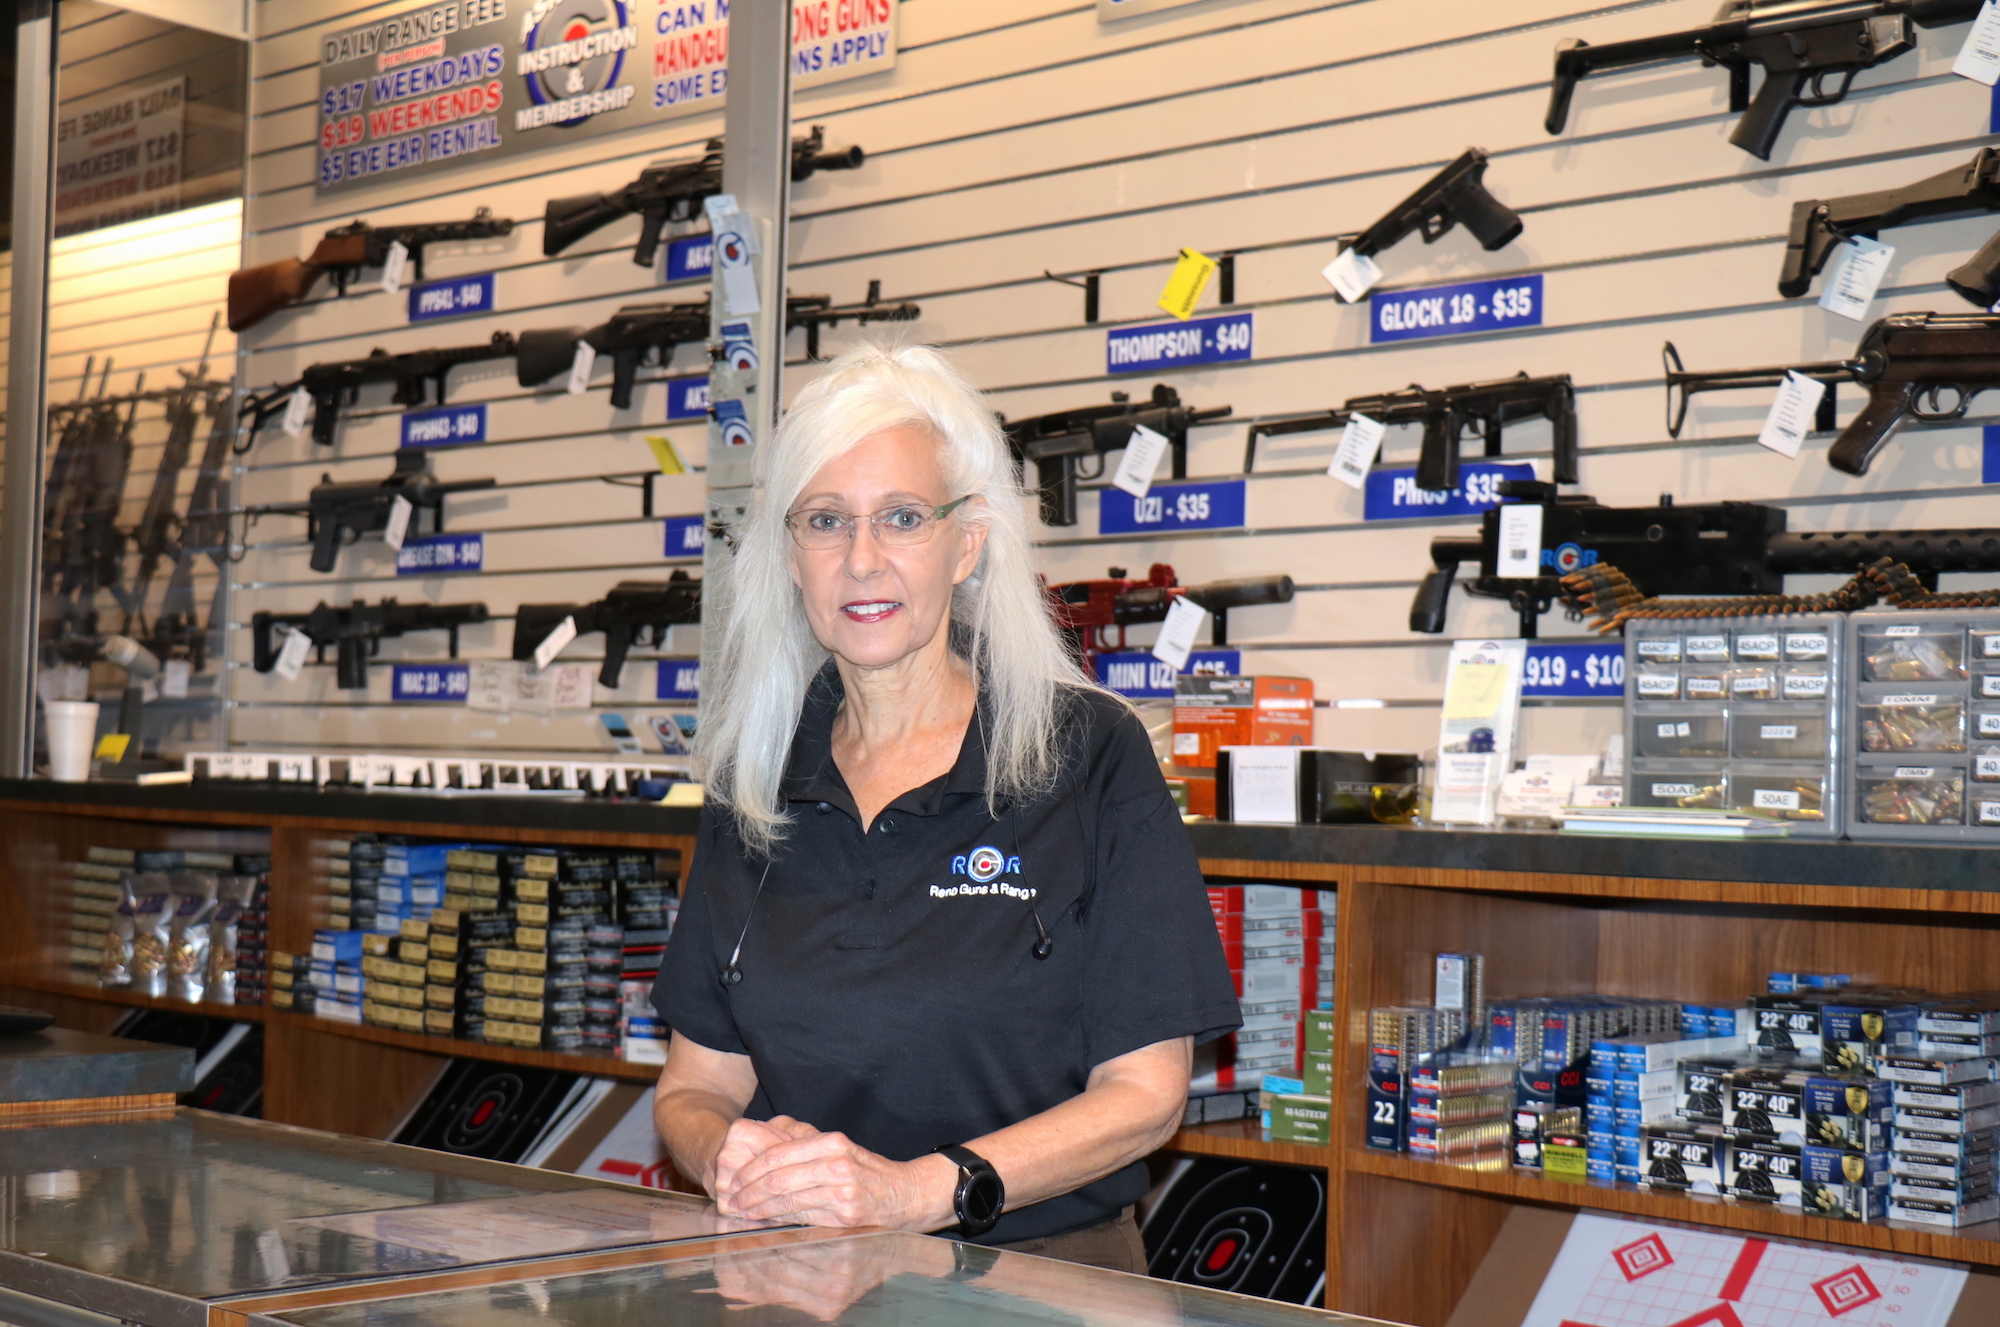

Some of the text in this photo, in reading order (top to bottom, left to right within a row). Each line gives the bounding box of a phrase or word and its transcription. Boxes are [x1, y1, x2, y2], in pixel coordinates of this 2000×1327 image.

[656, 4, 705, 35] CAN
[836, 0, 891, 33] GUNS
[325, 0, 506, 66] DAILY RANGE FEE
[517, 25, 638, 76] INSTRUCTION
[829, 29, 890, 68] APPLY
[324, 44, 504, 117] $17 WEEKDAYS
[566, 67, 585, 94] &
[653, 74, 705, 110] SOME
[322, 81, 503, 151] $19 WEEKENDS
[515, 84, 636, 132] MEMBERSHIP
[320, 152, 345, 186] $5
[428, 117, 502, 162] RENTAL
[1380, 297, 1445, 331] GLOCK
[1449, 294, 1475, 323] 18
[1492, 287, 1532, 321] $35
[1109, 328, 1202, 365] THOMPSON
[1216, 322, 1250, 354] $40
[1465, 472, 1504, 505] $35
[1134, 496, 1163, 523] UZI
[1176, 492, 1210, 523] $35
[1688, 638, 1722, 650] 45ACP
[1738, 640, 1775, 652] 45ACP
[1788, 639, 1825, 650] 45ACP
[1107, 662, 1146, 689] MINI
[1521, 655, 1566, 687] 919
[1584, 653, 1625, 688] $10
[401, 671, 424, 694] MAC
[425, 671, 440, 693] 10
[447, 671, 468, 695] $40
[1641, 678, 1675, 690] 45ACP
[1787, 678, 1823, 690] 45ACP
[1662, 725, 1673, 734] 50
[1985, 719, 1999, 728] 40
[1983, 761, 1997, 771] 40
[1762, 794, 1790, 805] 50AE
[930, 884, 958, 898] Reno
[959, 883, 988, 895] Guns
[989, 883, 999, 894] &
[1760, 1011, 1808, 1030] 22 40
[1381, 1082, 1398, 1091] CCI
[1533, 1081, 1550, 1090] CCI
[1560, 1071, 1580, 1086] CCI
[1690, 1075, 1708, 1092] 22
[1373, 1100, 1395, 1124] 22
[1737, 1091, 1788, 1113] 22 40
[1284, 1107, 1328, 1120] MAGTECH
[1652, 1140, 1701, 1162] 22 40
[1738, 1151, 1789, 1174] 22 40
[1893, 1285, 1910, 1294] 5D
[1885, 1304, 1901, 1313] 4D
